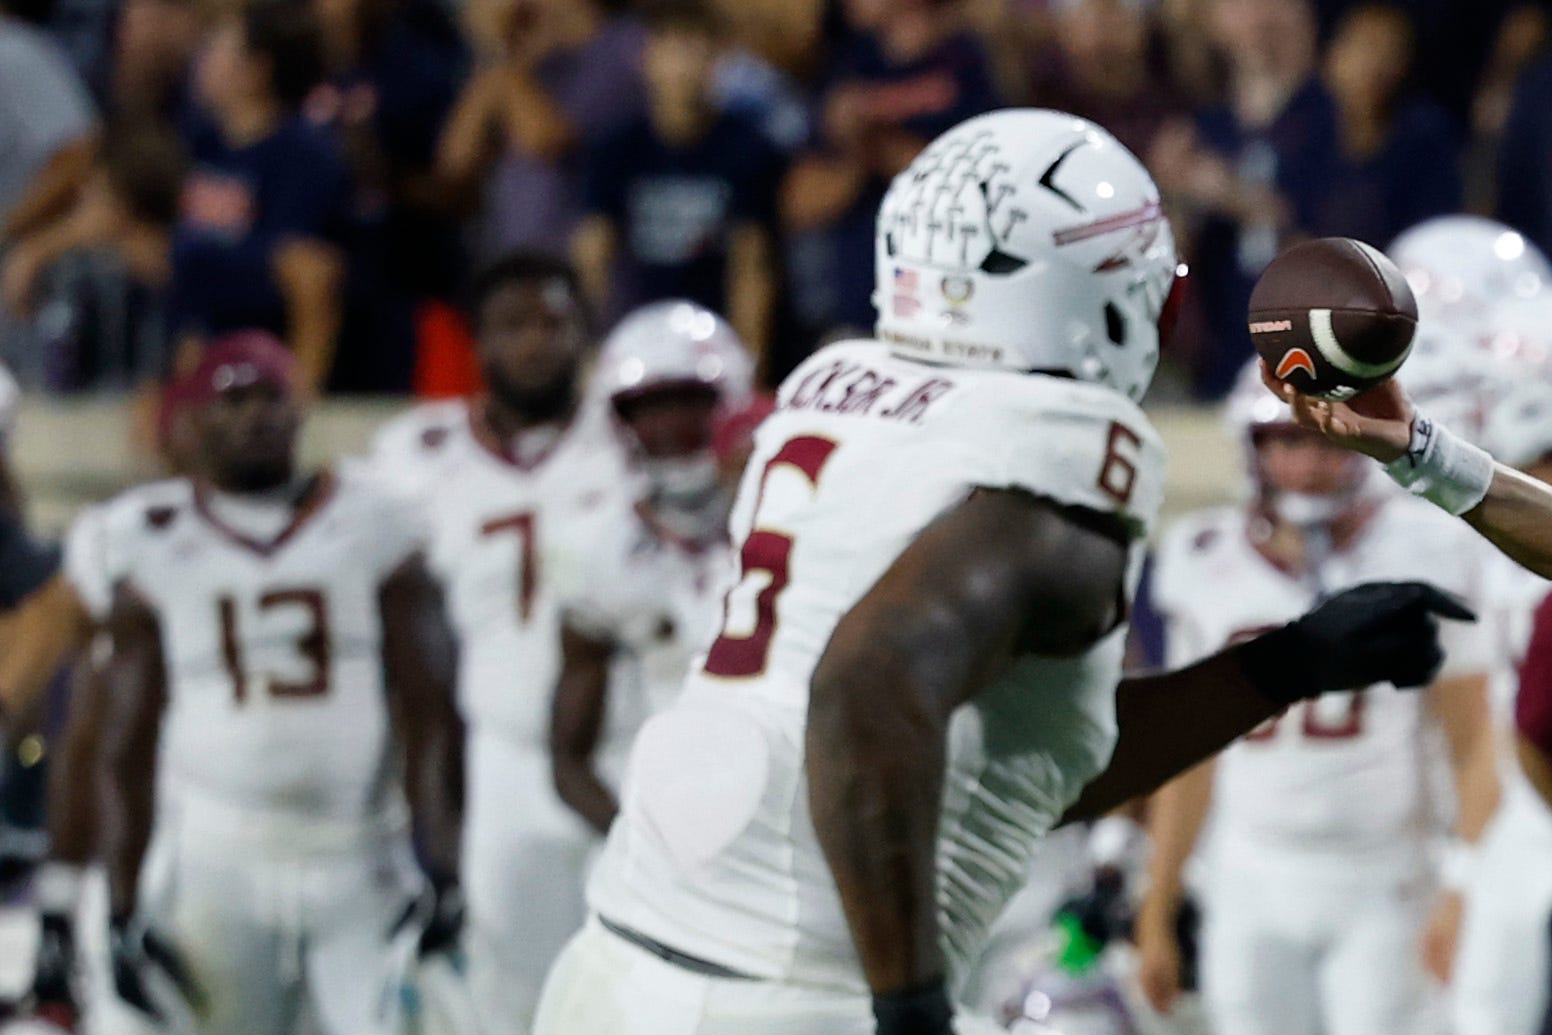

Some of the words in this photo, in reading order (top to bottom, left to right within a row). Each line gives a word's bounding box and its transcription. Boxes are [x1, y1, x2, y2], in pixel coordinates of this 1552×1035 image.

[1098, 420, 1142, 503] 6
[481, 510, 536, 625] 7
[702, 432, 842, 678] 6
[220, 587, 333, 705] 13
